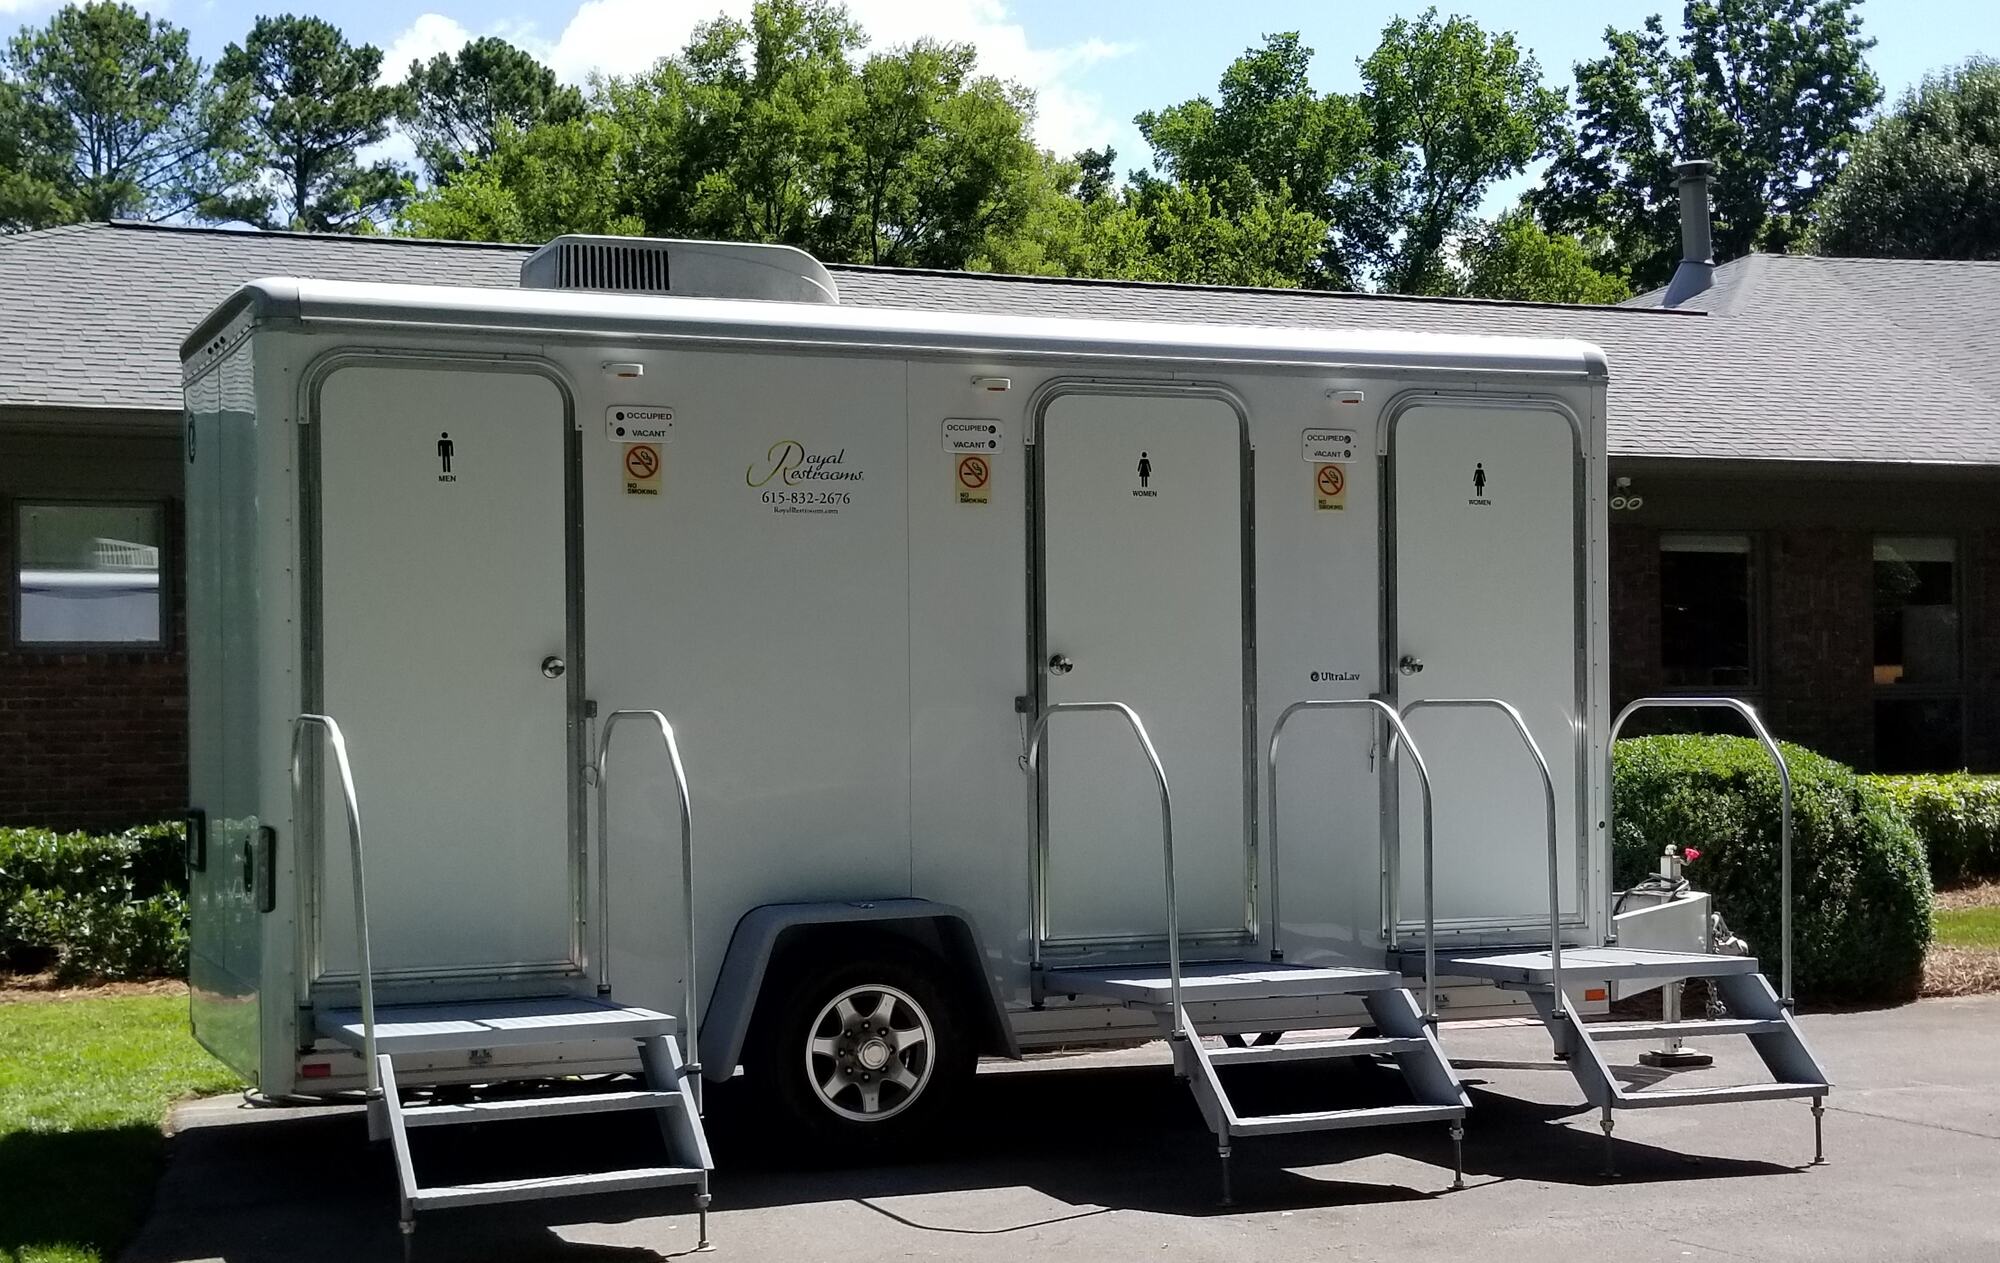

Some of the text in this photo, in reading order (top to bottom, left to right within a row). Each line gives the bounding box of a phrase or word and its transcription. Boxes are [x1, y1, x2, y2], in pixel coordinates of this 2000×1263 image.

[626, 412, 672, 420] OCCUPIED
[946, 424, 988, 432] OCCUPIED
[1306, 434, 1345, 442] OCCUPIED
[953, 441, 986, 449] VACANT
[1314, 450, 1342, 458] VACANT
[783, 465, 864, 487] Restrooms
[627, 488, 658, 496] SMOKING
[761, 491, 851, 505] 615-832-2676
[1320, 671, 1361, 681] UltraLav
